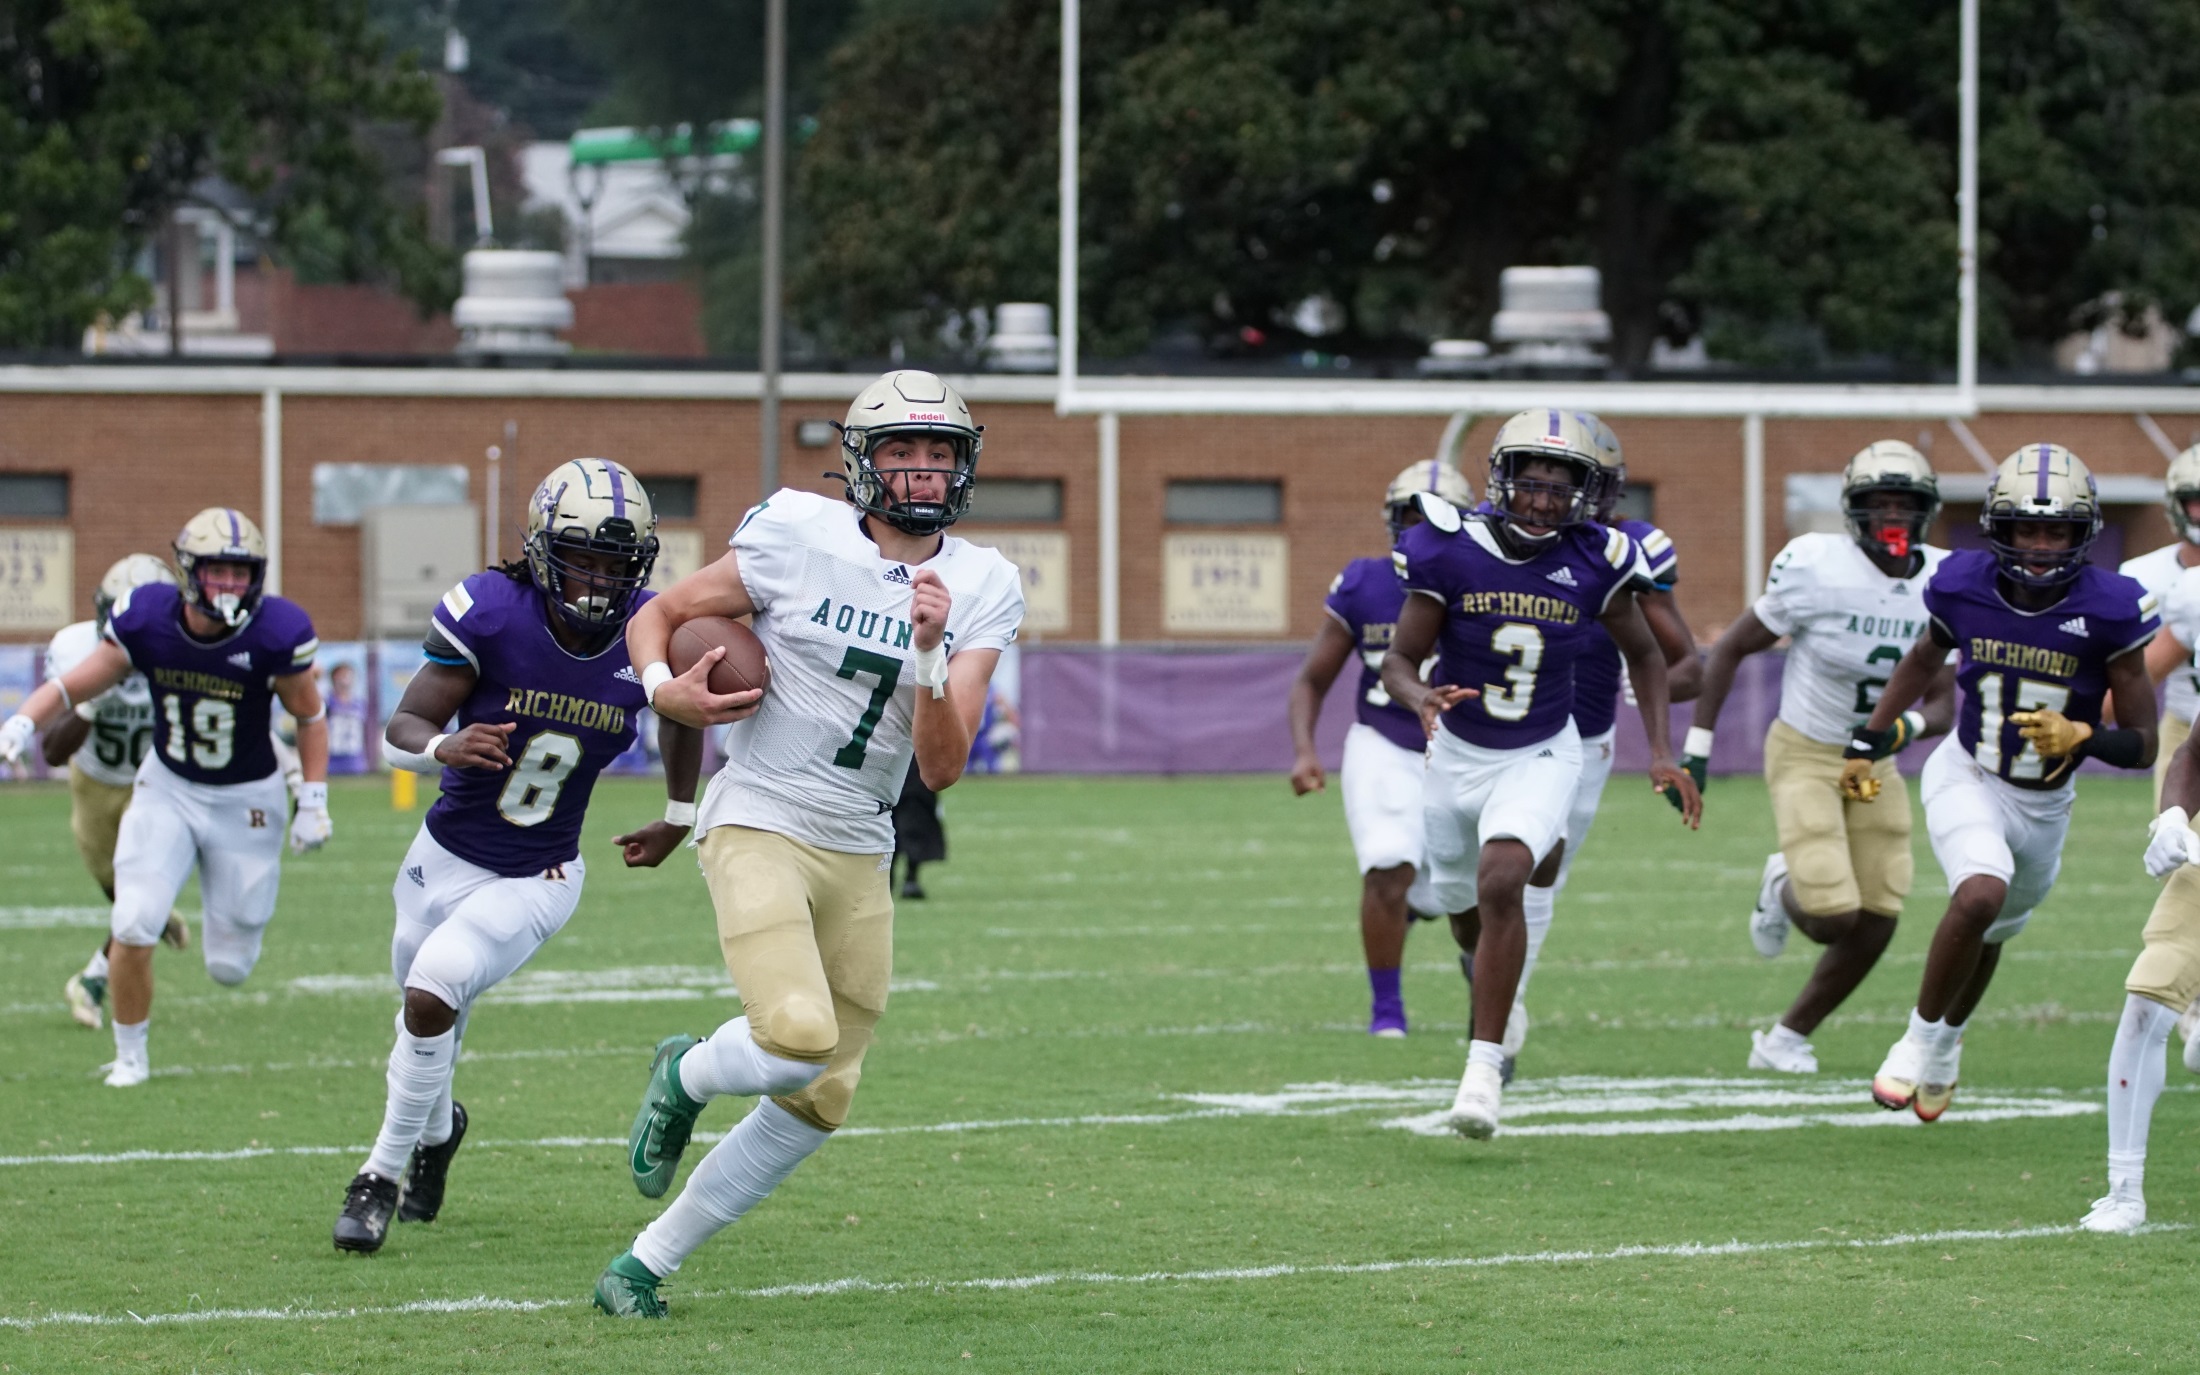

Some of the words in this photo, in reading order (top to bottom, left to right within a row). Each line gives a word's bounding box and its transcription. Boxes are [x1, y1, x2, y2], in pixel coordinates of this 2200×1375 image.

[909, 413, 945, 421] Riddell
[811, 597, 954, 660] AQUINS
[1463, 592, 1579, 624] RICHMOND
[1846, 614, 1927, 639] AQUINA
[1482, 621, 1545, 722] 3
[1853, 645, 1903, 713] 2
[1971, 638, 2079, 678] RICHMOND
[163, 693, 236, 769] 19
[504, 687, 625, 734] RICHMOND
[833, 645, 904, 770] 7
[1975, 671, 2072, 780] 17
[496, 729, 584, 827] 8
[249, 807, 267, 828] R
